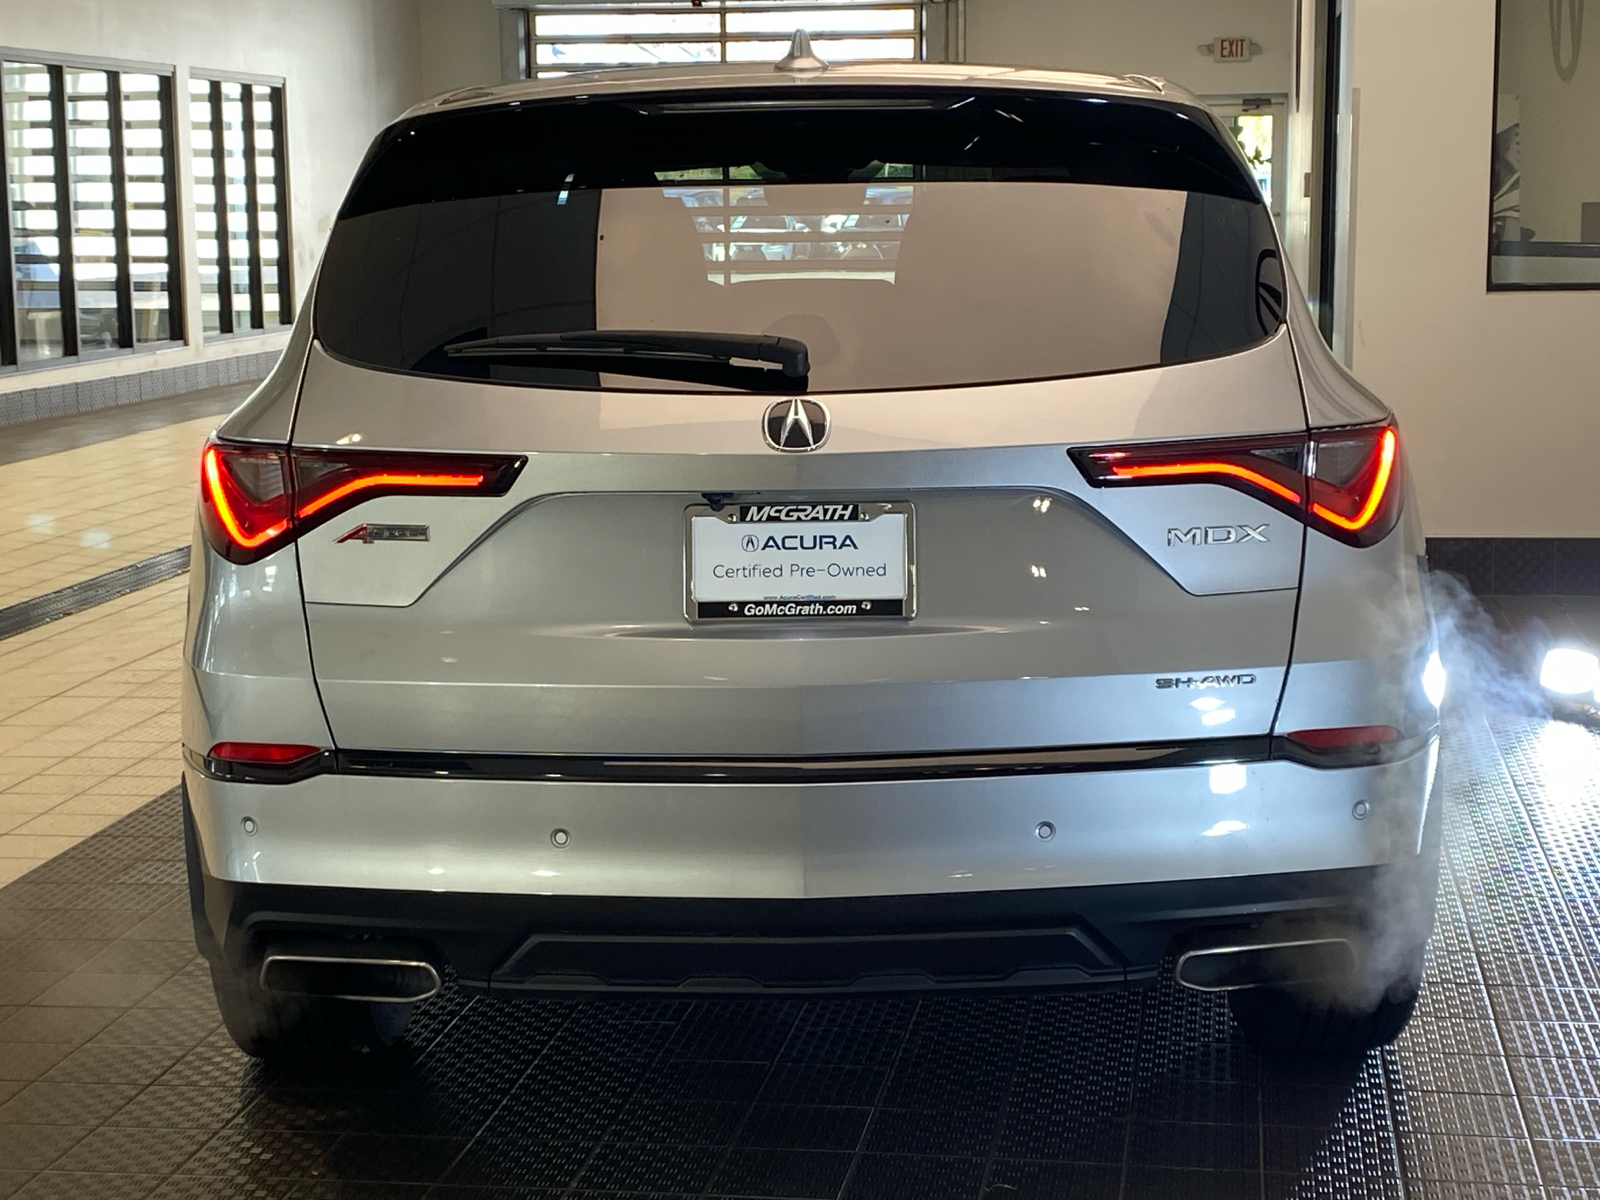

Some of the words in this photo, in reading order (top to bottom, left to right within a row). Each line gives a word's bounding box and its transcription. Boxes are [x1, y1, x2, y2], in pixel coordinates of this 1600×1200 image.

[1220, 38, 1246, 58] EXIT
[761, 534, 858, 551] ACURA
[1167, 523, 1270, 547] MDX
[712, 563, 783, 579] Certified
[790, 562, 887, 578] Pre-Owned
[744, 602, 857, 616] GoMcGrath.com
[1155, 673, 1257, 689] SH-AWD
